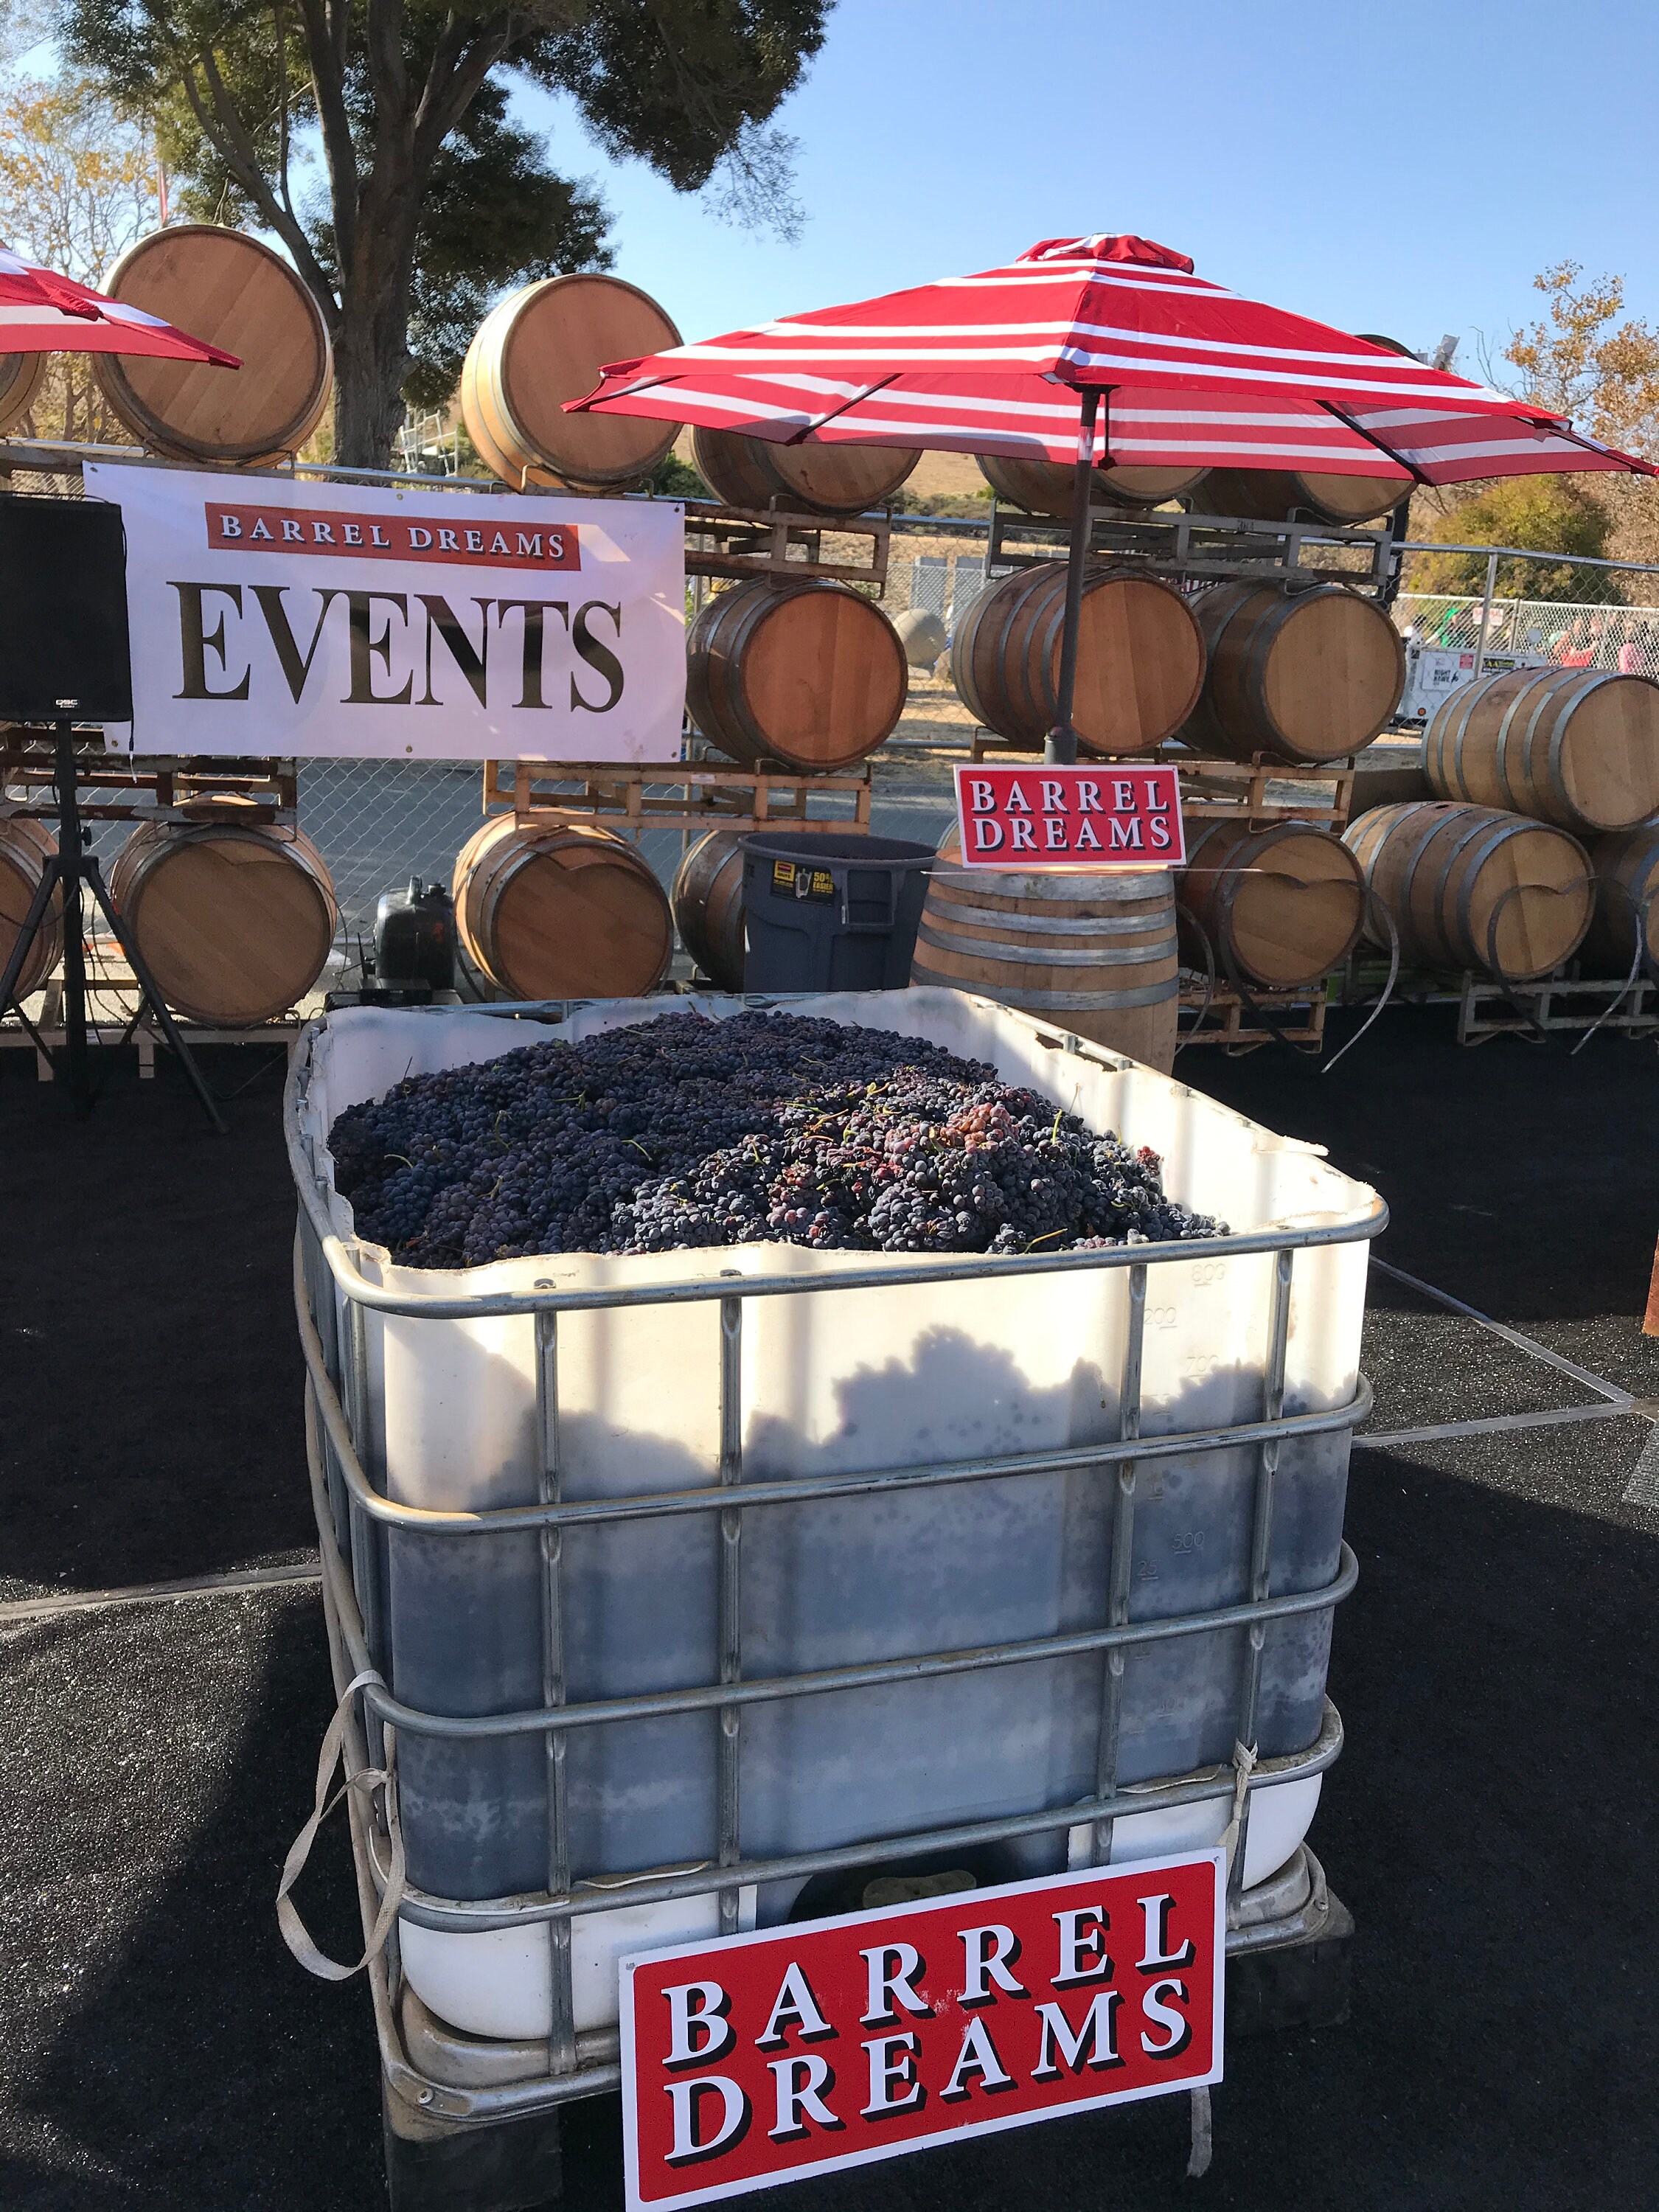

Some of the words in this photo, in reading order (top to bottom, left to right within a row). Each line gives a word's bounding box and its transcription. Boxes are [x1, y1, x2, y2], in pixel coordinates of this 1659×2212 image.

[220, 514, 392, 549] BARREL
[408, 526, 566, 560] DREAMS
[167, 581, 625, 714] EVENTS
[969, 780, 1169, 814] BARREL
[972, 816, 1172, 852] DREAMS
[1171, 1531, 1205, 1550] 500
[660, 1893, 1197, 2069] BARREL
[664, 1978, 1192, 2168] DREAMS
